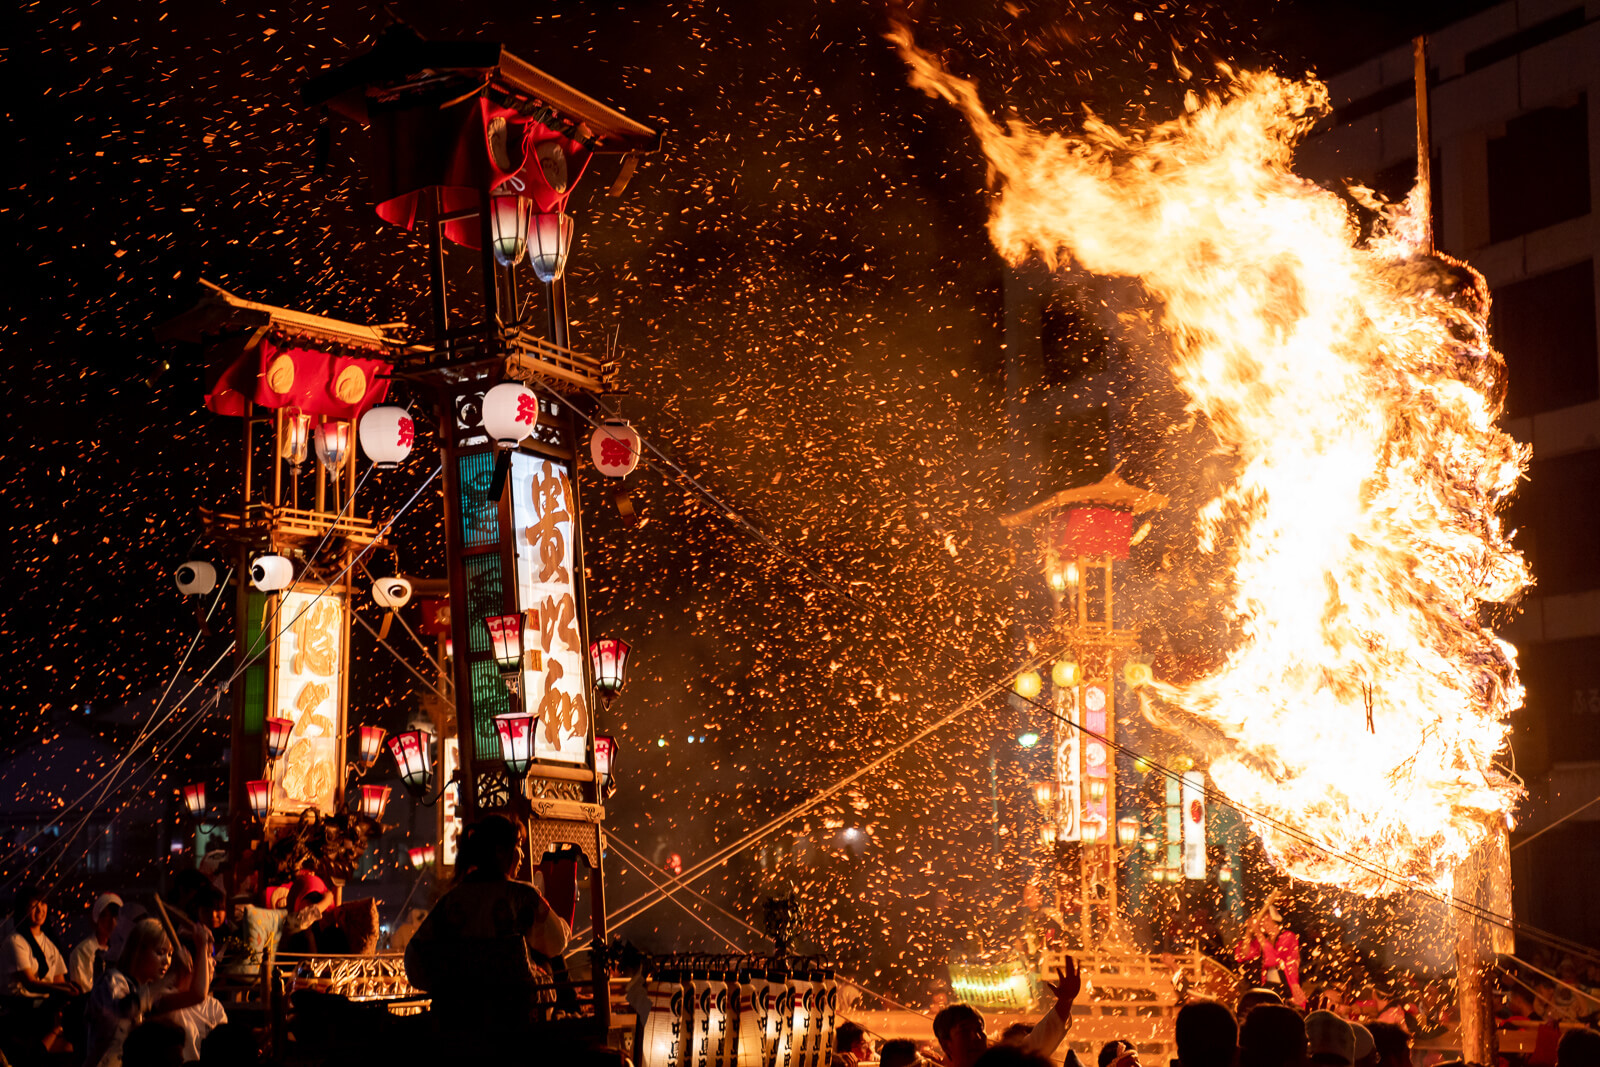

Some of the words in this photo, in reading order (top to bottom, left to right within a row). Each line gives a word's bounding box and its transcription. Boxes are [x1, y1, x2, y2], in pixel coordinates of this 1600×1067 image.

[515, 393, 536, 425] 祭
[397, 416, 415, 447] 祭
[601, 437, 631, 467] 祭
